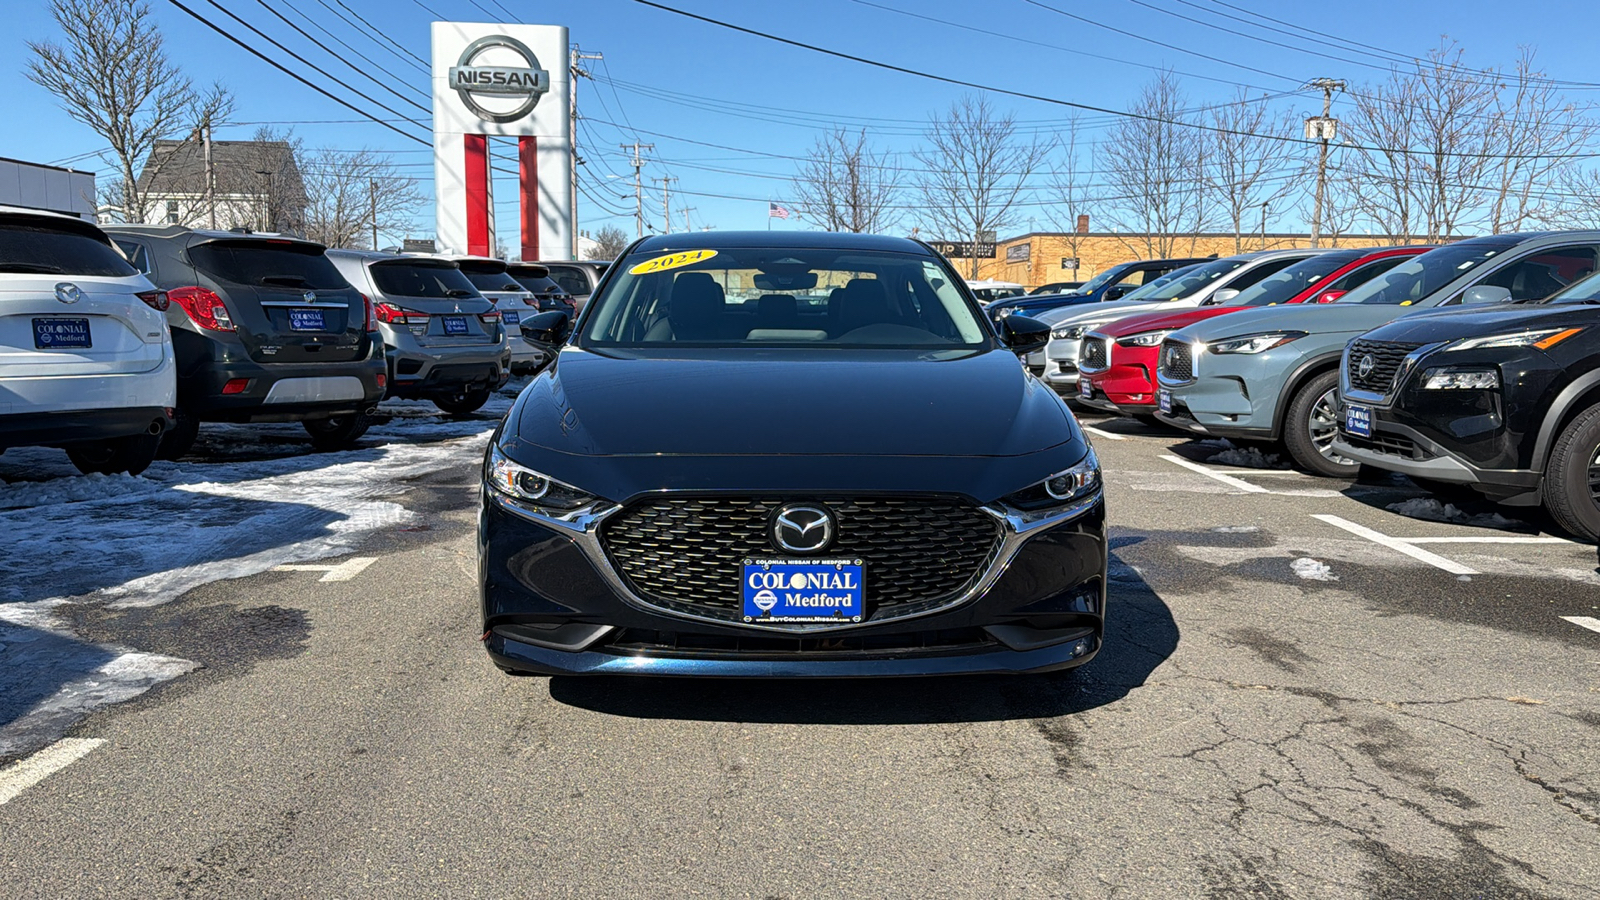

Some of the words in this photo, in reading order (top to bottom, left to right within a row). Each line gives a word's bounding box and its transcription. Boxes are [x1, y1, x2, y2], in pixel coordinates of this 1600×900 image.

[457, 70, 539, 87] NISSAN
[647, 251, 703, 271] 2024
[37, 324, 86, 334] COLONIAL
[749, 572, 857, 590] COLONIAL
[784, 593, 852, 607] Medford
